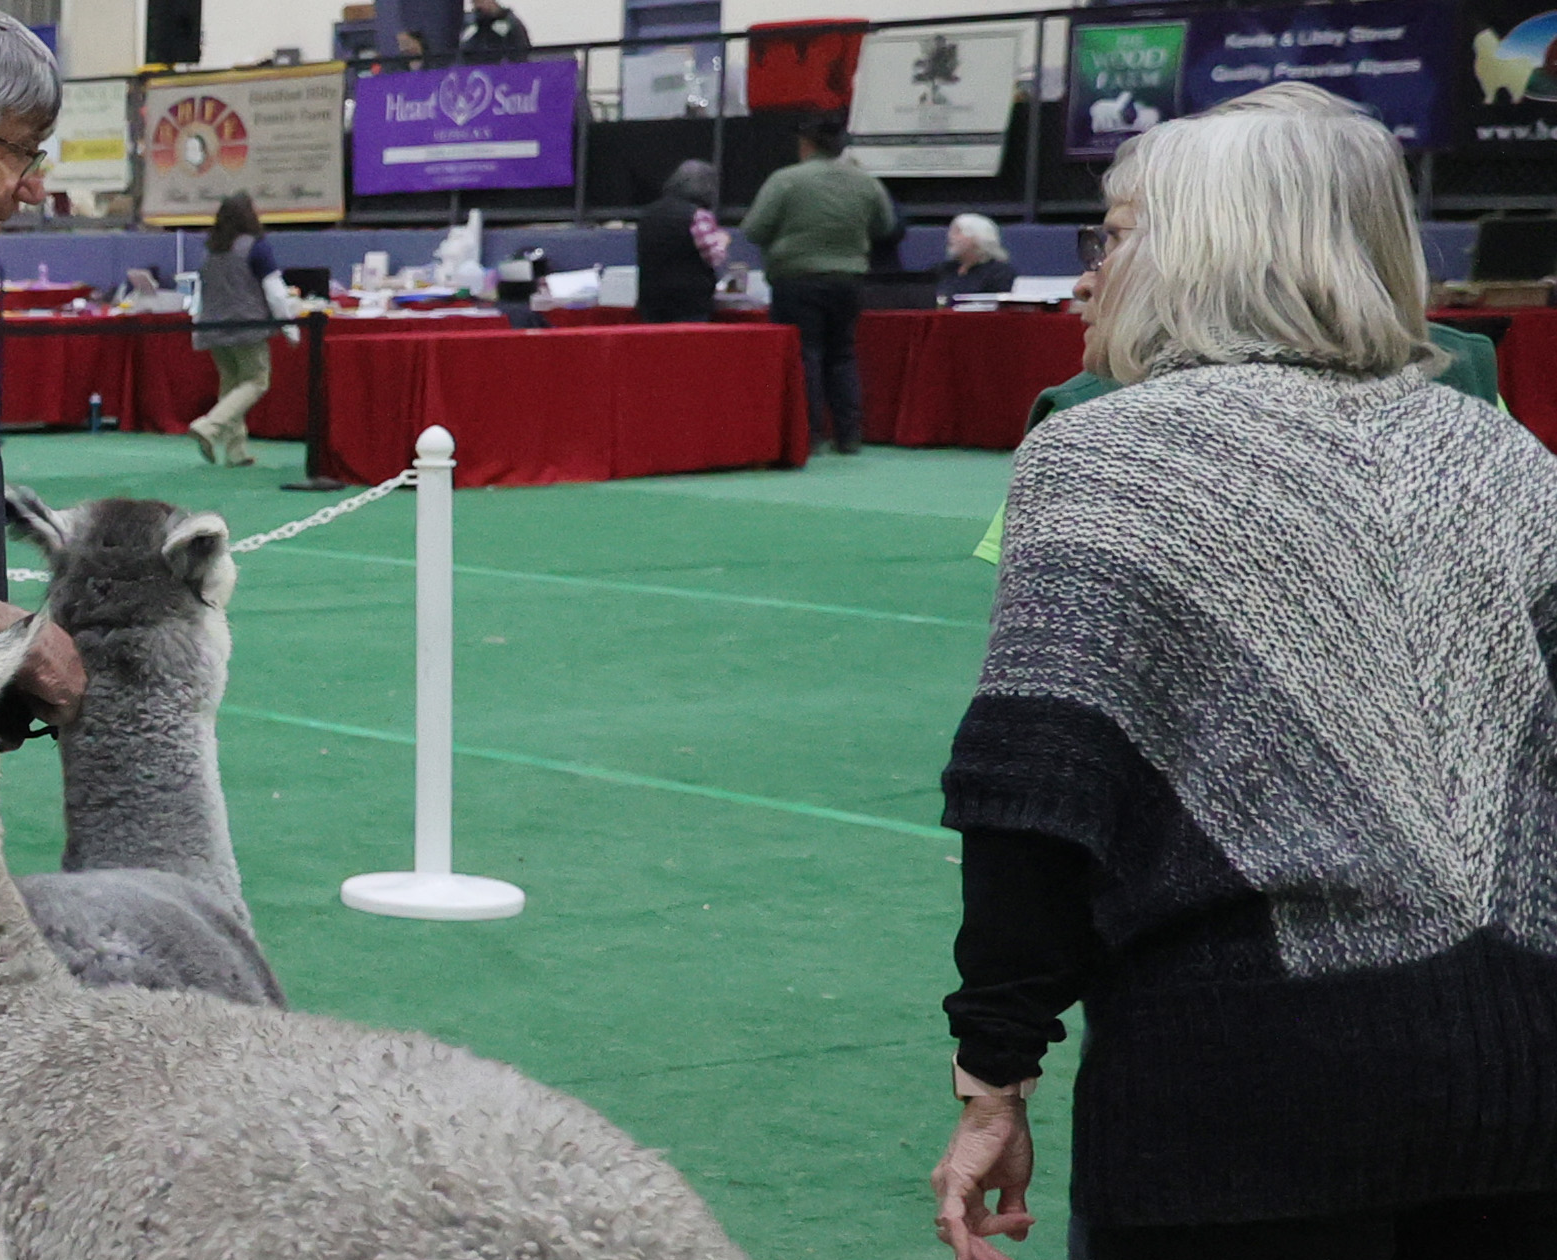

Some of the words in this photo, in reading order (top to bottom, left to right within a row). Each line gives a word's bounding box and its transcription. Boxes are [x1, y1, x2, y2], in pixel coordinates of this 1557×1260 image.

[1091, 48, 1167, 70] WOOD
[1211, 64, 1270, 83] Quality
[1273, 62, 1353, 79] Peruvian
[385, 90, 437, 121] Heart
[493, 78, 540, 115] Soul
